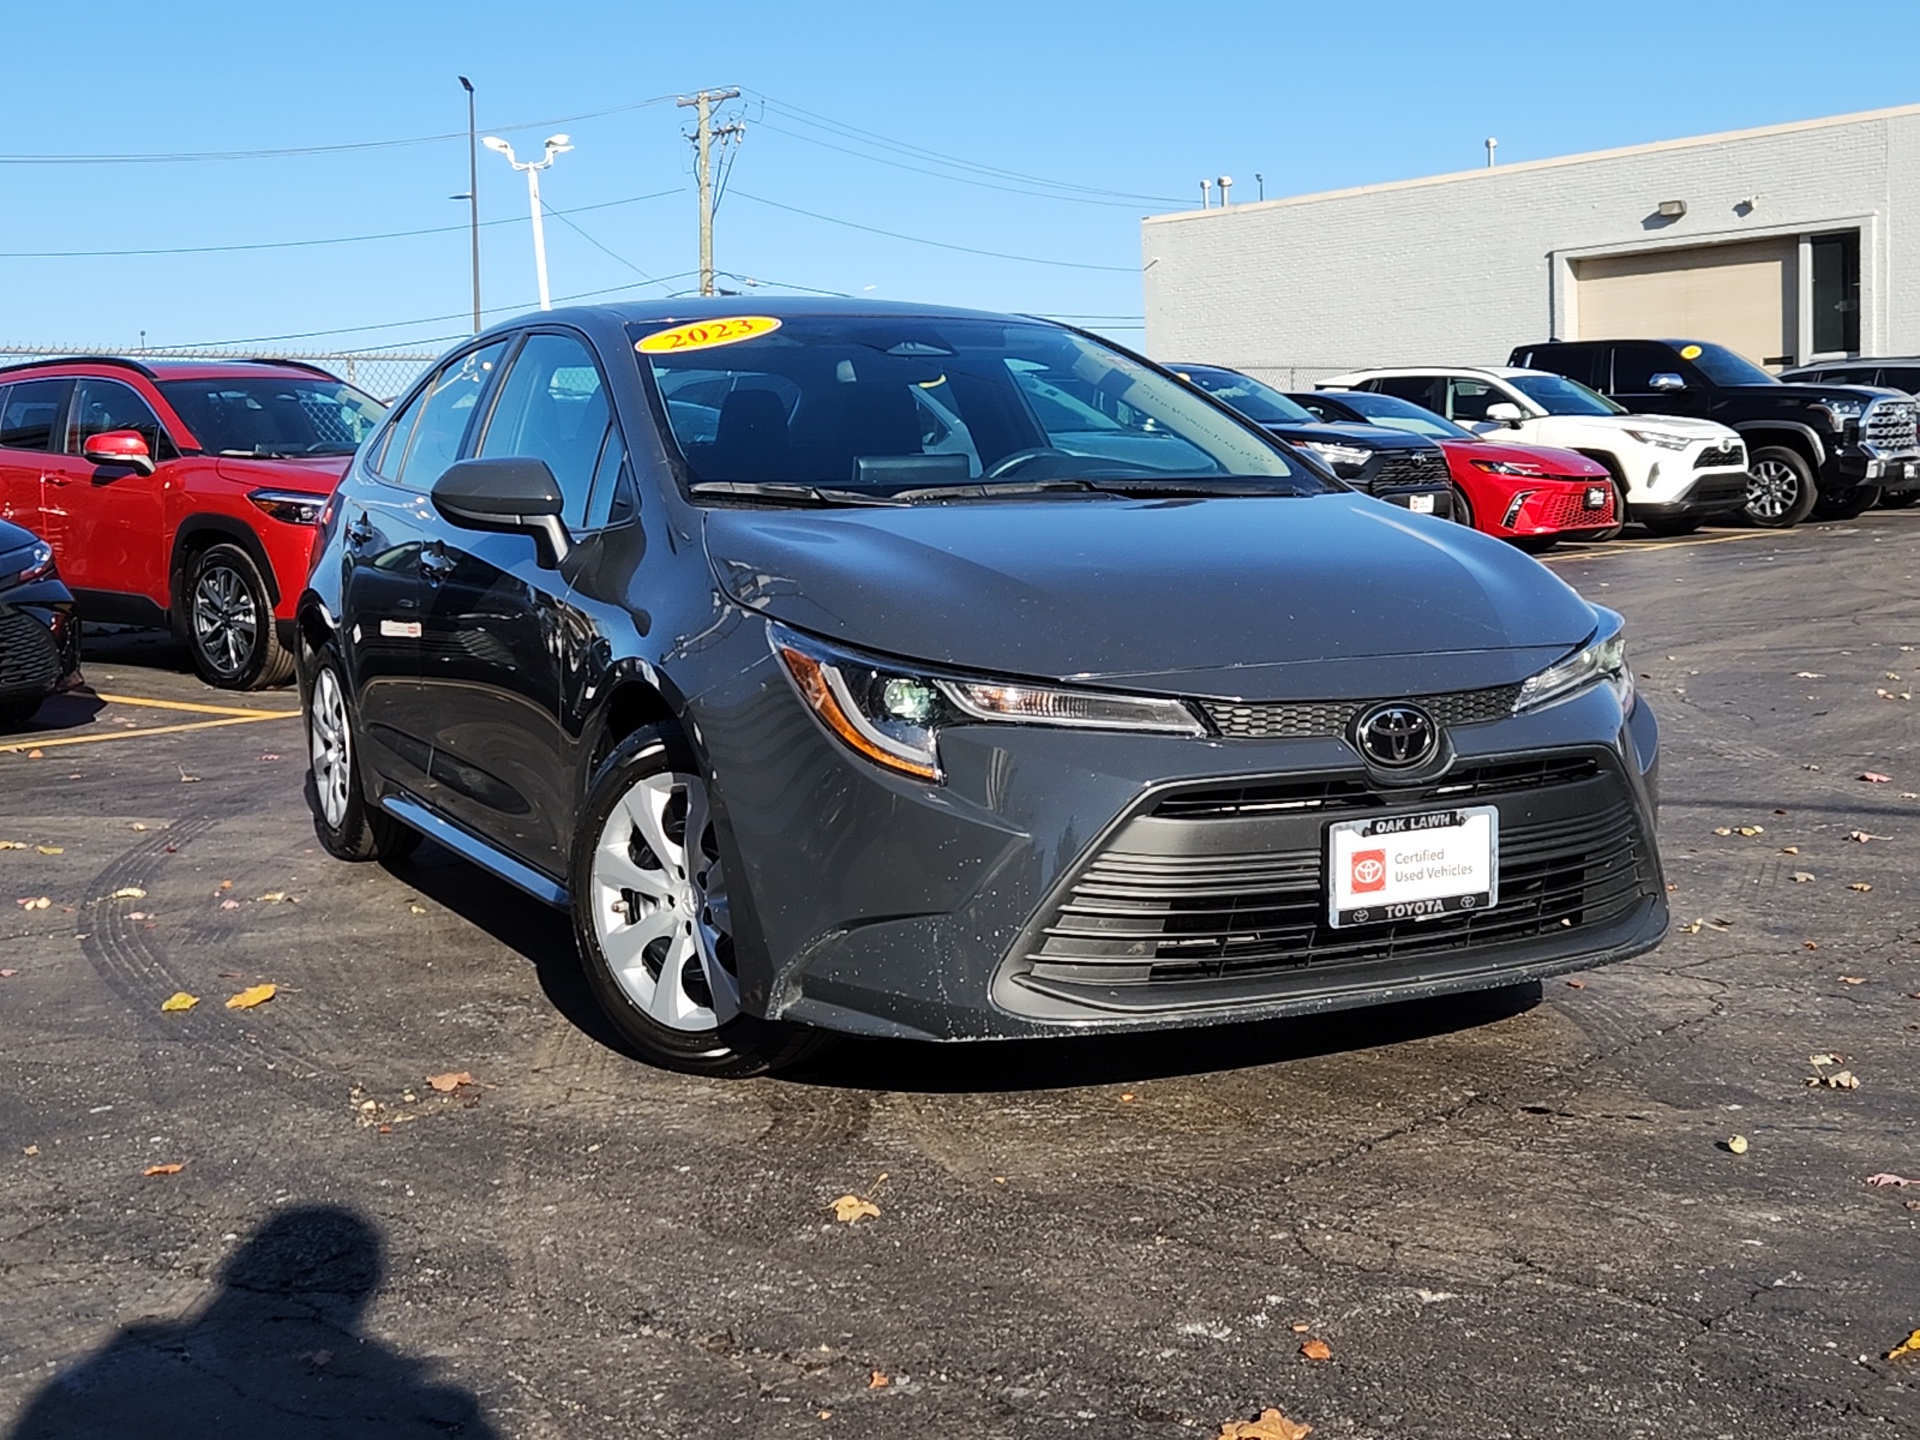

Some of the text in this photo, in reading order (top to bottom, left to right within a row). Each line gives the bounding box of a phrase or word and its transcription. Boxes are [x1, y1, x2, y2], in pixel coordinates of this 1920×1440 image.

[664, 319, 754, 349] 2023
[1375, 813, 1451, 834] OAK LAWN
[1394, 848, 1445, 865] Certified
[1395, 864, 1473, 883] Used Vehicles
[1385, 899, 1444, 919] TOYOTA
